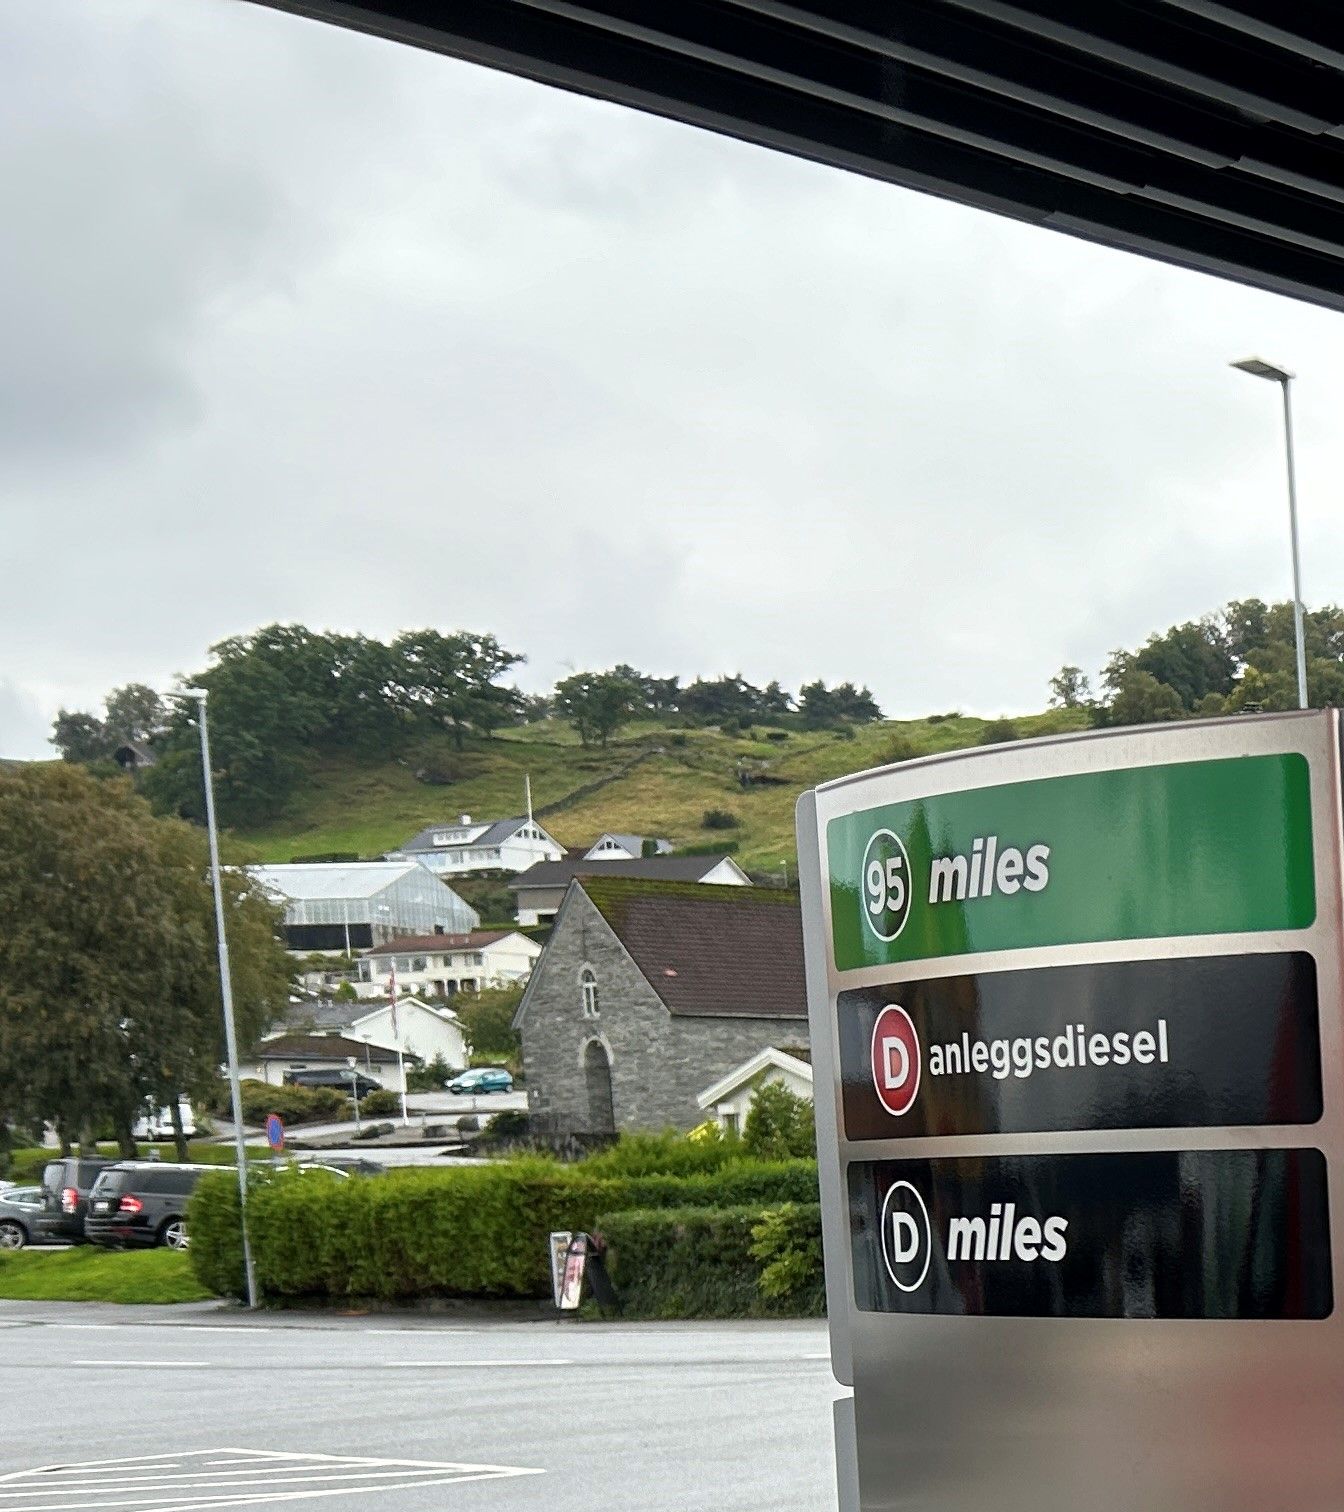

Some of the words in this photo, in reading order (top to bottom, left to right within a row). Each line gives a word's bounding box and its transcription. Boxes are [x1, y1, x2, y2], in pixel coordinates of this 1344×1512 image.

[866, 855, 906, 916] 95
[928, 835, 1051, 905] miles
[881, 1036, 910, 1091] D
[929, 1019, 1170, 1081] anleggsdiesel
[891, 1211, 920, 1264] D
[946, 1203, 1070, 1262] miles
